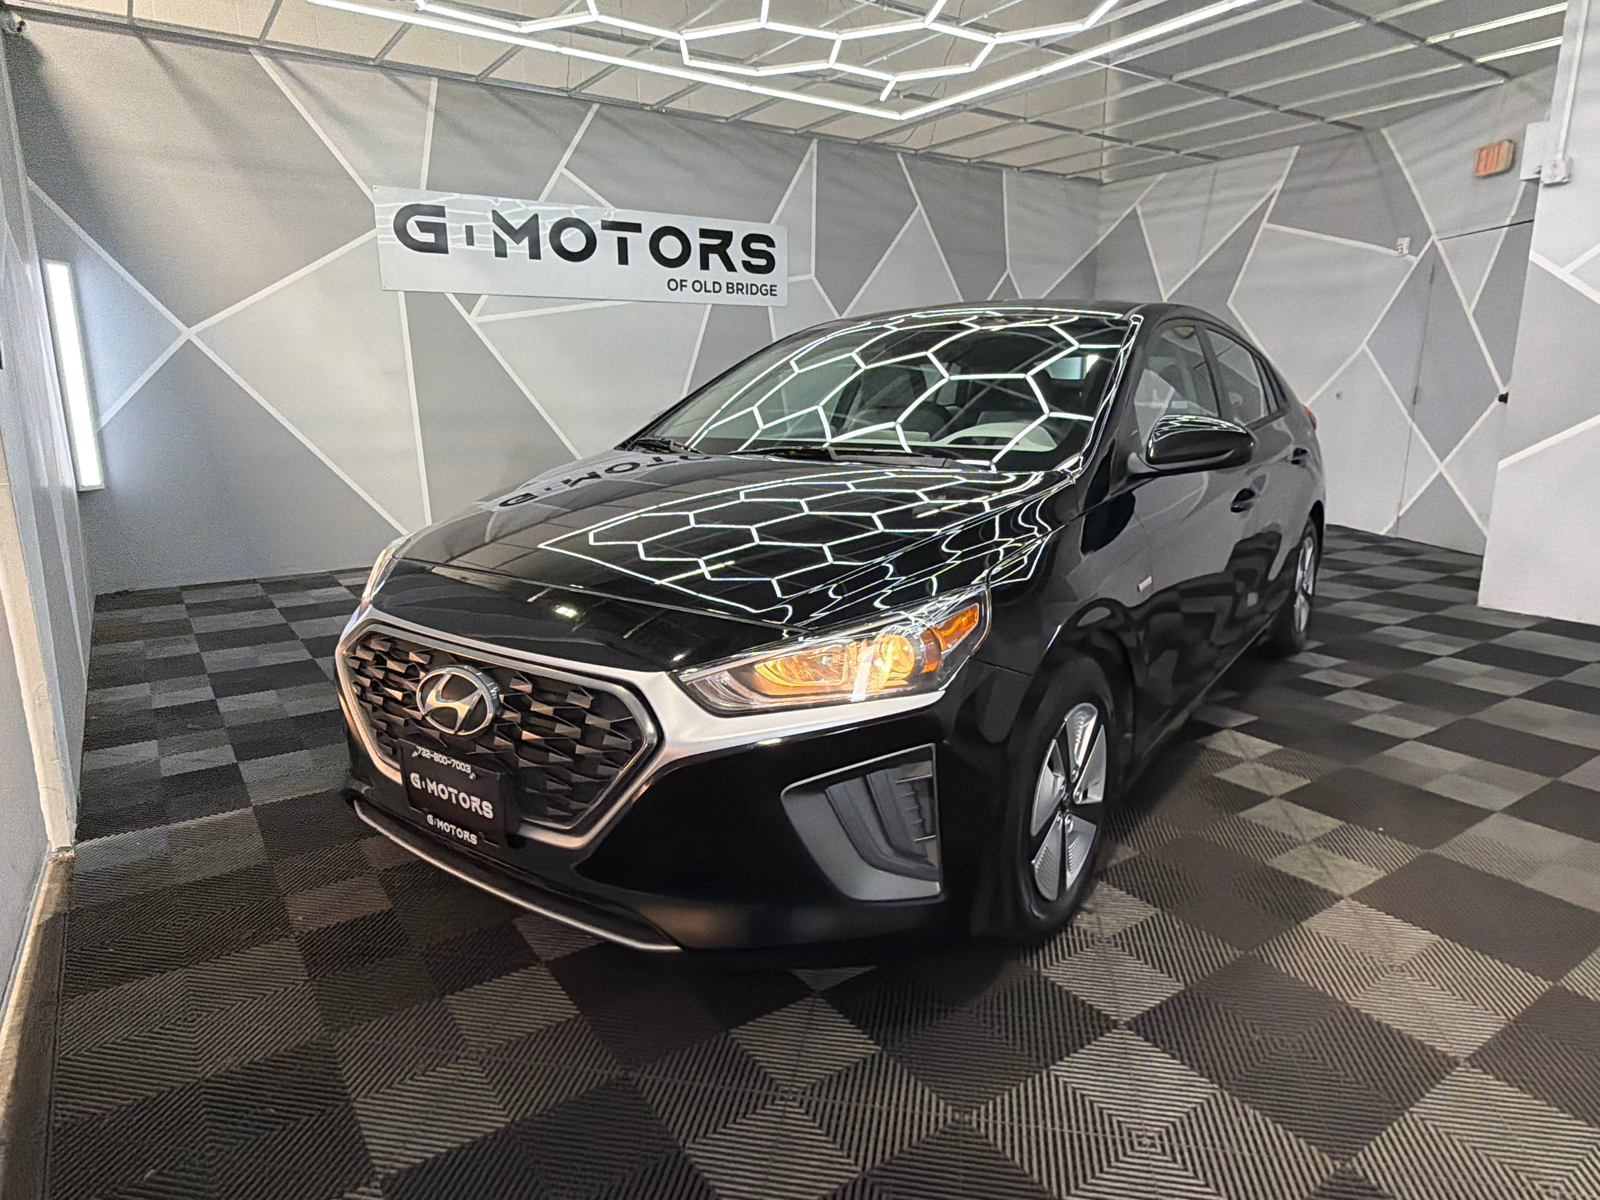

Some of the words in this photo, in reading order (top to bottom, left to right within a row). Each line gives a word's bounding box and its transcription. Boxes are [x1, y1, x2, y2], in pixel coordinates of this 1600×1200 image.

[491, 209, 777, 275] MOTORS
[666, 278, 688, 292] OF
[692, 279, 722, 294] OLD
[725, 281, 778, 297] BRIDGE
[425, 777, 494, 819] MOTORS
[436, 818, 478, 845] MOTORS
